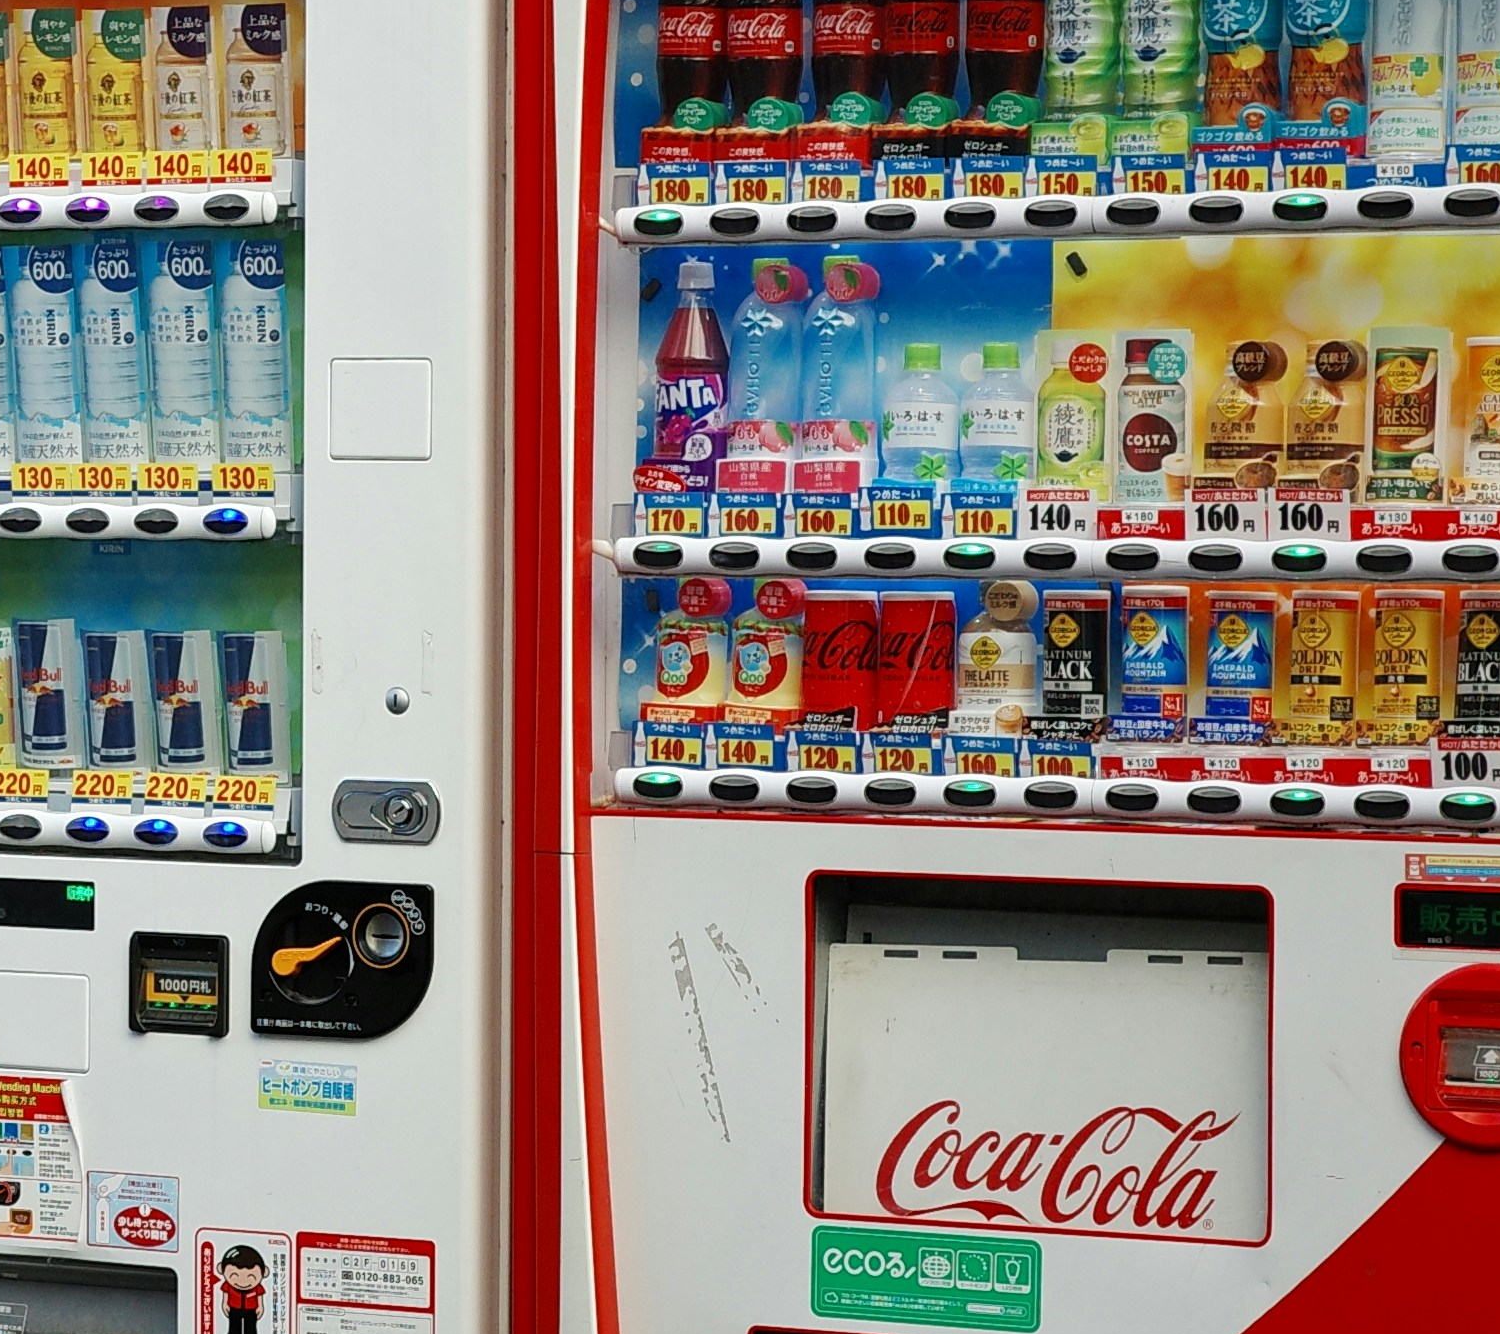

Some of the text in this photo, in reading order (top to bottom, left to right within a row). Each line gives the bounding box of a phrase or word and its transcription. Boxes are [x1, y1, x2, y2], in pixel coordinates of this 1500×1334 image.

[172, 17, 203, 29] 上品な
[170, 30, 206, 44] ミルク感
[89, 155, 135, 179] 140円
[1381, 165, 1410, 175] ¥160
[808, 176, 854, 200] 180円
[970, 174, 1018, 197] 180円
[1130, 170, 1181, 193] 150円
[1212, 169, 1263, 192] 140円
[1289, 166, 1341, 191] 140円
[654, 178, 704, 203] 180円
[732, 179, 781, 202] 180円
[245, 244, 277, 255] たっぷり
[257, 305, 266, 343] KIRIN
[1235, 352, 1265, 364] 高級豆
[1236, 364, 1264, 373] ブレンド
[1477, 403, 1493, 413] AU
[1211, 422, 1256, 434] 香る微糖
[1126, 435, 1171, 447] COSTA
[728, 462, 772, 473] 山梨県産
[145, 467, 191, 489] 130円
[1194, 491, 1258, 501] HOT/あたたかい
[651, 509, 697, 533] 170円
[724, 509, 771, 533] 160円
[800, 510, 847, 534] 160円
[877, 503, 925, 527] 110円
[960, 510, 1006, 534] 110円
[1029, 504, 1085, 532] 140円
[1125, 512, 1153, 522] ¥180
[1195, 503, 1255, 533] 160円
[1278, 503, 1339, 533] 160円
[1379, 512, 1408, 523] ¥130
[1464, 513, 1493, 523] ¥140
[40, 668, 62, 682] Bull
[661, 670, 686, 685] Qoo
[740, 670, 765, 685] Qoo
[246, 680, 268, 694] Bull
[895, 715, 947, 725] ゼロシュガー
[650, 739, 697, 763] 140円
[722, 739, 769, 765] 140円
[804, 747, 852, 771] 120円
[879, 747, 927, 772] 120円
[1127, 758, 1155, 769] ¥120
[1210, 758, 1238, 769] ¥120
[1292, 758, 1320, 769] ¥120
[1378, 758, 1406, 770] ¥120
[75, 774, 126, 798] 220円
[159, 977, 212, 993] 1000円札
[262, 1078, 354, 1101] ヒートポンプ自販機
[877, 1100, 1242, 1230] Coca-Cola
[356, 1272, 423, 1285] 0120-883-065
